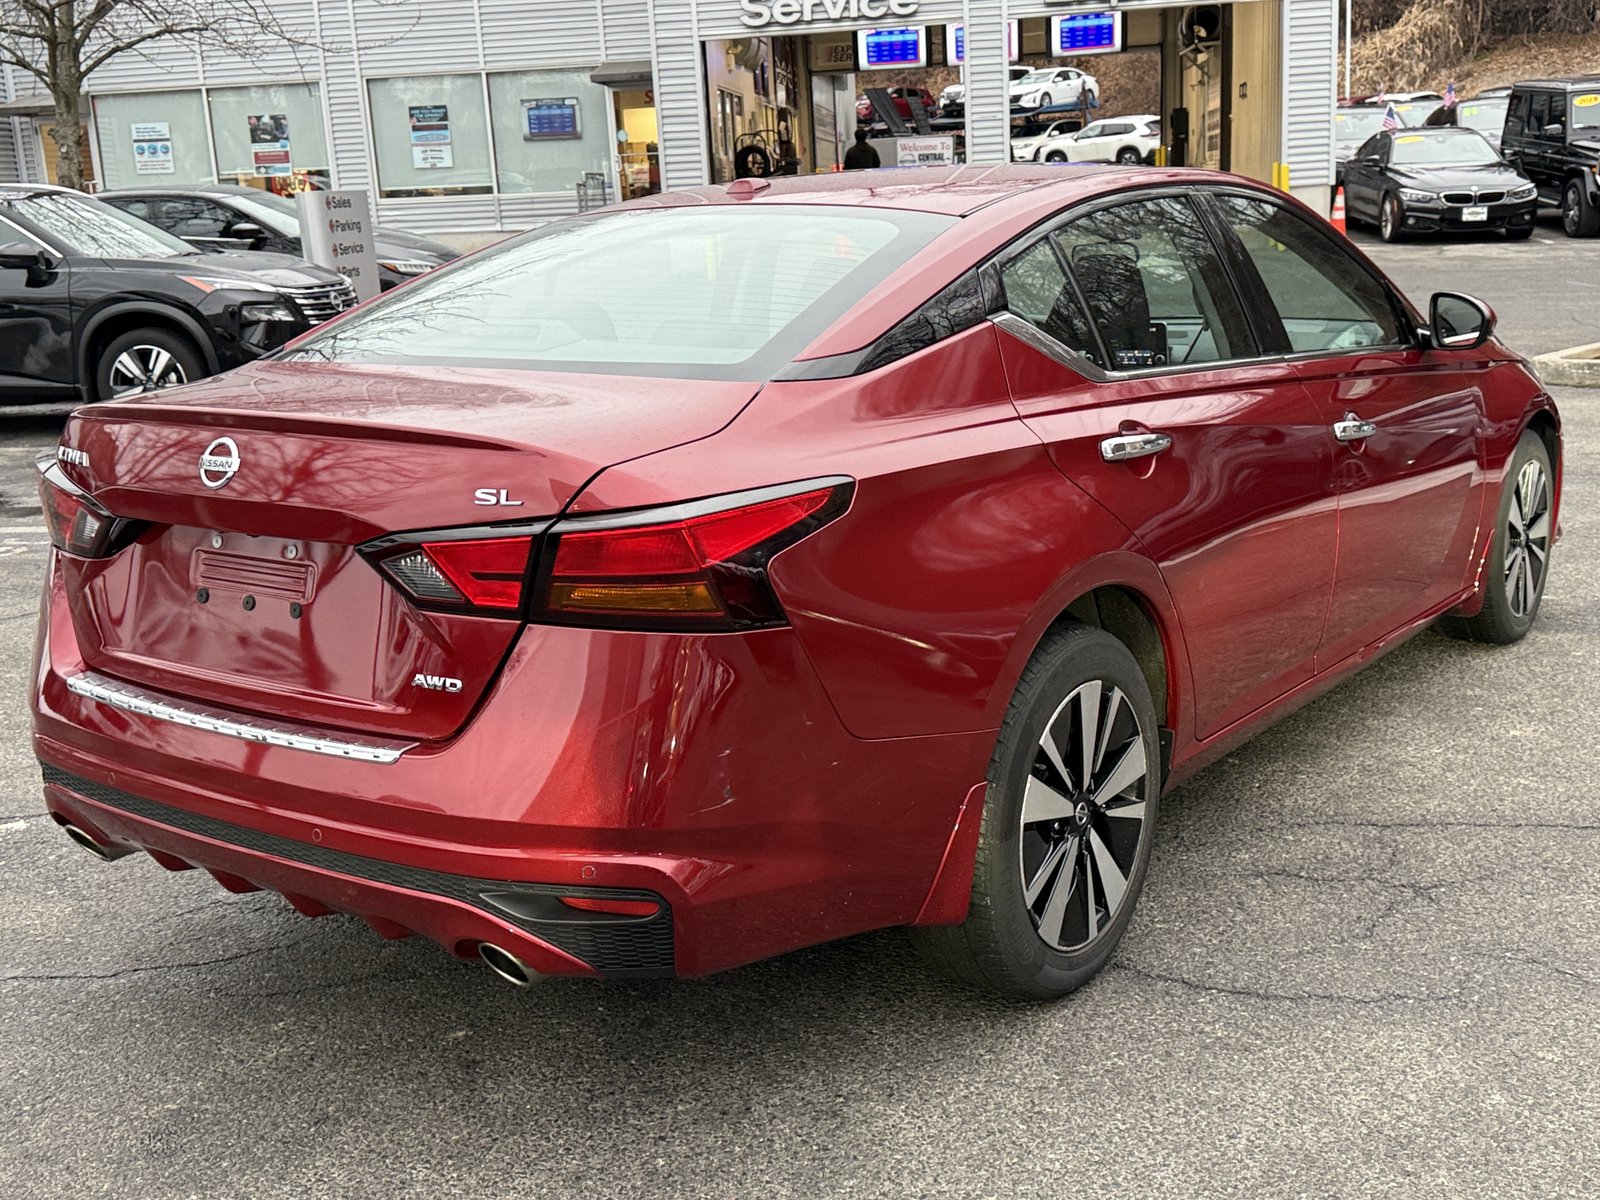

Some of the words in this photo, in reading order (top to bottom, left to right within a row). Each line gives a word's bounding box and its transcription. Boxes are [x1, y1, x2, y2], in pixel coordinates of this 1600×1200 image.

[739, 0, 919, 27] Service
[899, 142, 938, 152] Welcome
[939, 141, 951, 151] To
[331, 195, 352, 210] Sales
[335, 218, 362, 233] Parking
[338, 242, 365, 256] Service
[342, 266, 361, 277] Parts
[199, 456, 233, 469] NISSAN
[473, 487, 525, 506] SL
[411, 673, 463, 693] AWD
